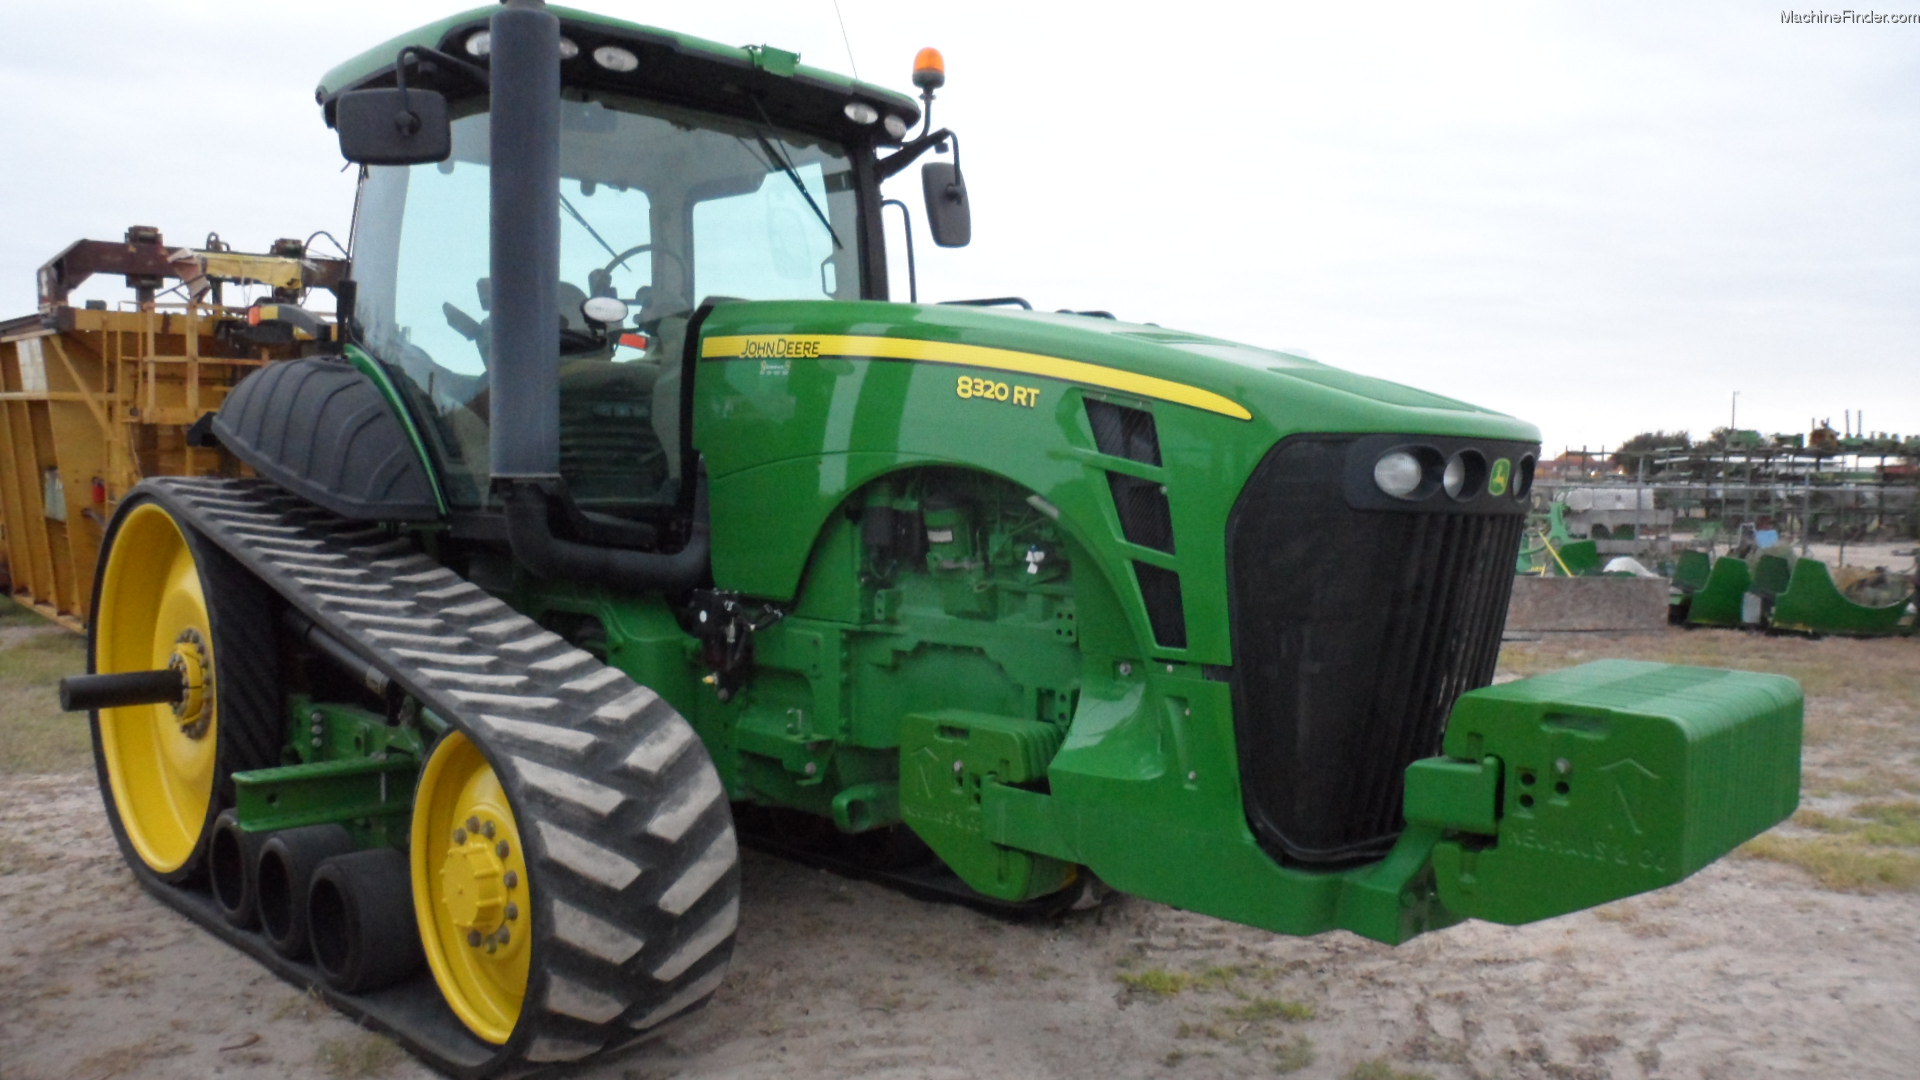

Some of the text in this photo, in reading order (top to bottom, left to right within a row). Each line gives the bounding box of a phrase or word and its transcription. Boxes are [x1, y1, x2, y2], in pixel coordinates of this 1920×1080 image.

[740, 338, 821, 356] JOHN DEERE
[957, 376, 1040, 408] 8320 RT
